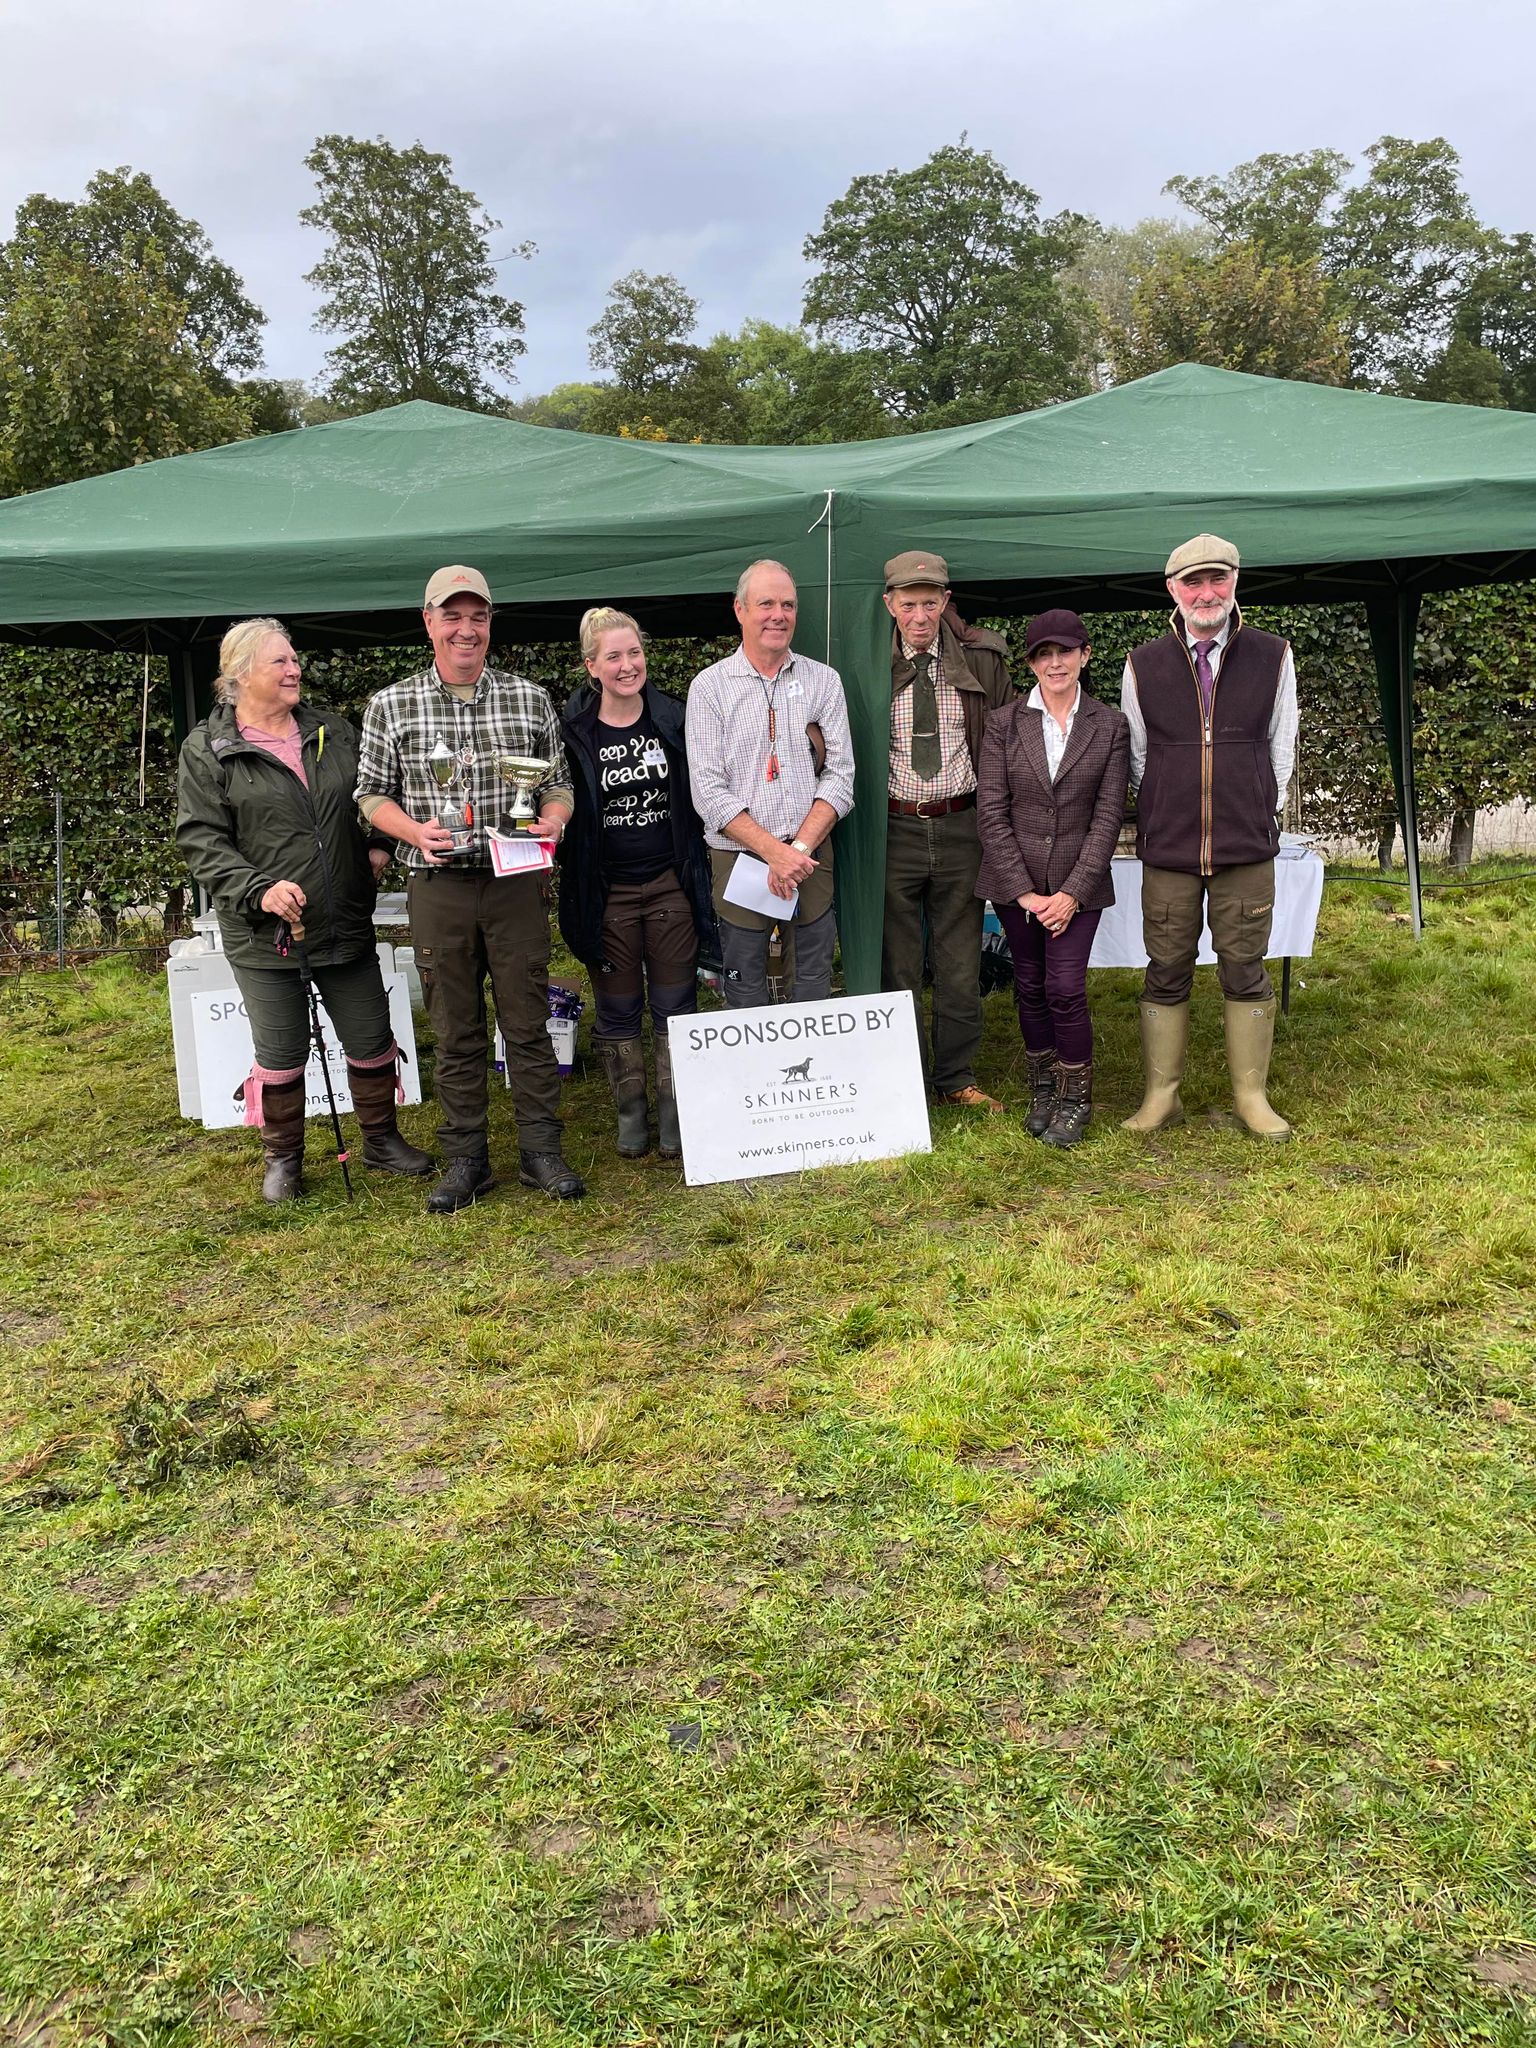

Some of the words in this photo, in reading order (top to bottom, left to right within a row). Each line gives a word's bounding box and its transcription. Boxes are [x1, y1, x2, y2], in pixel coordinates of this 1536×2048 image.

[599, 744, 628, 763] eep
[602, 795, 638, 811] eep
[688, 1012, 857, 1051] SPONSORED
[865, 1007, 895, 1031] BY
[744, 1083, 858, 1109] SKINNER'S
[752, 1116, 775, 1125] BORN
[808, 1107, 855, 1118] OUTDOORS
[738, 1131, 876, 1159] www.skinners.co.uk
